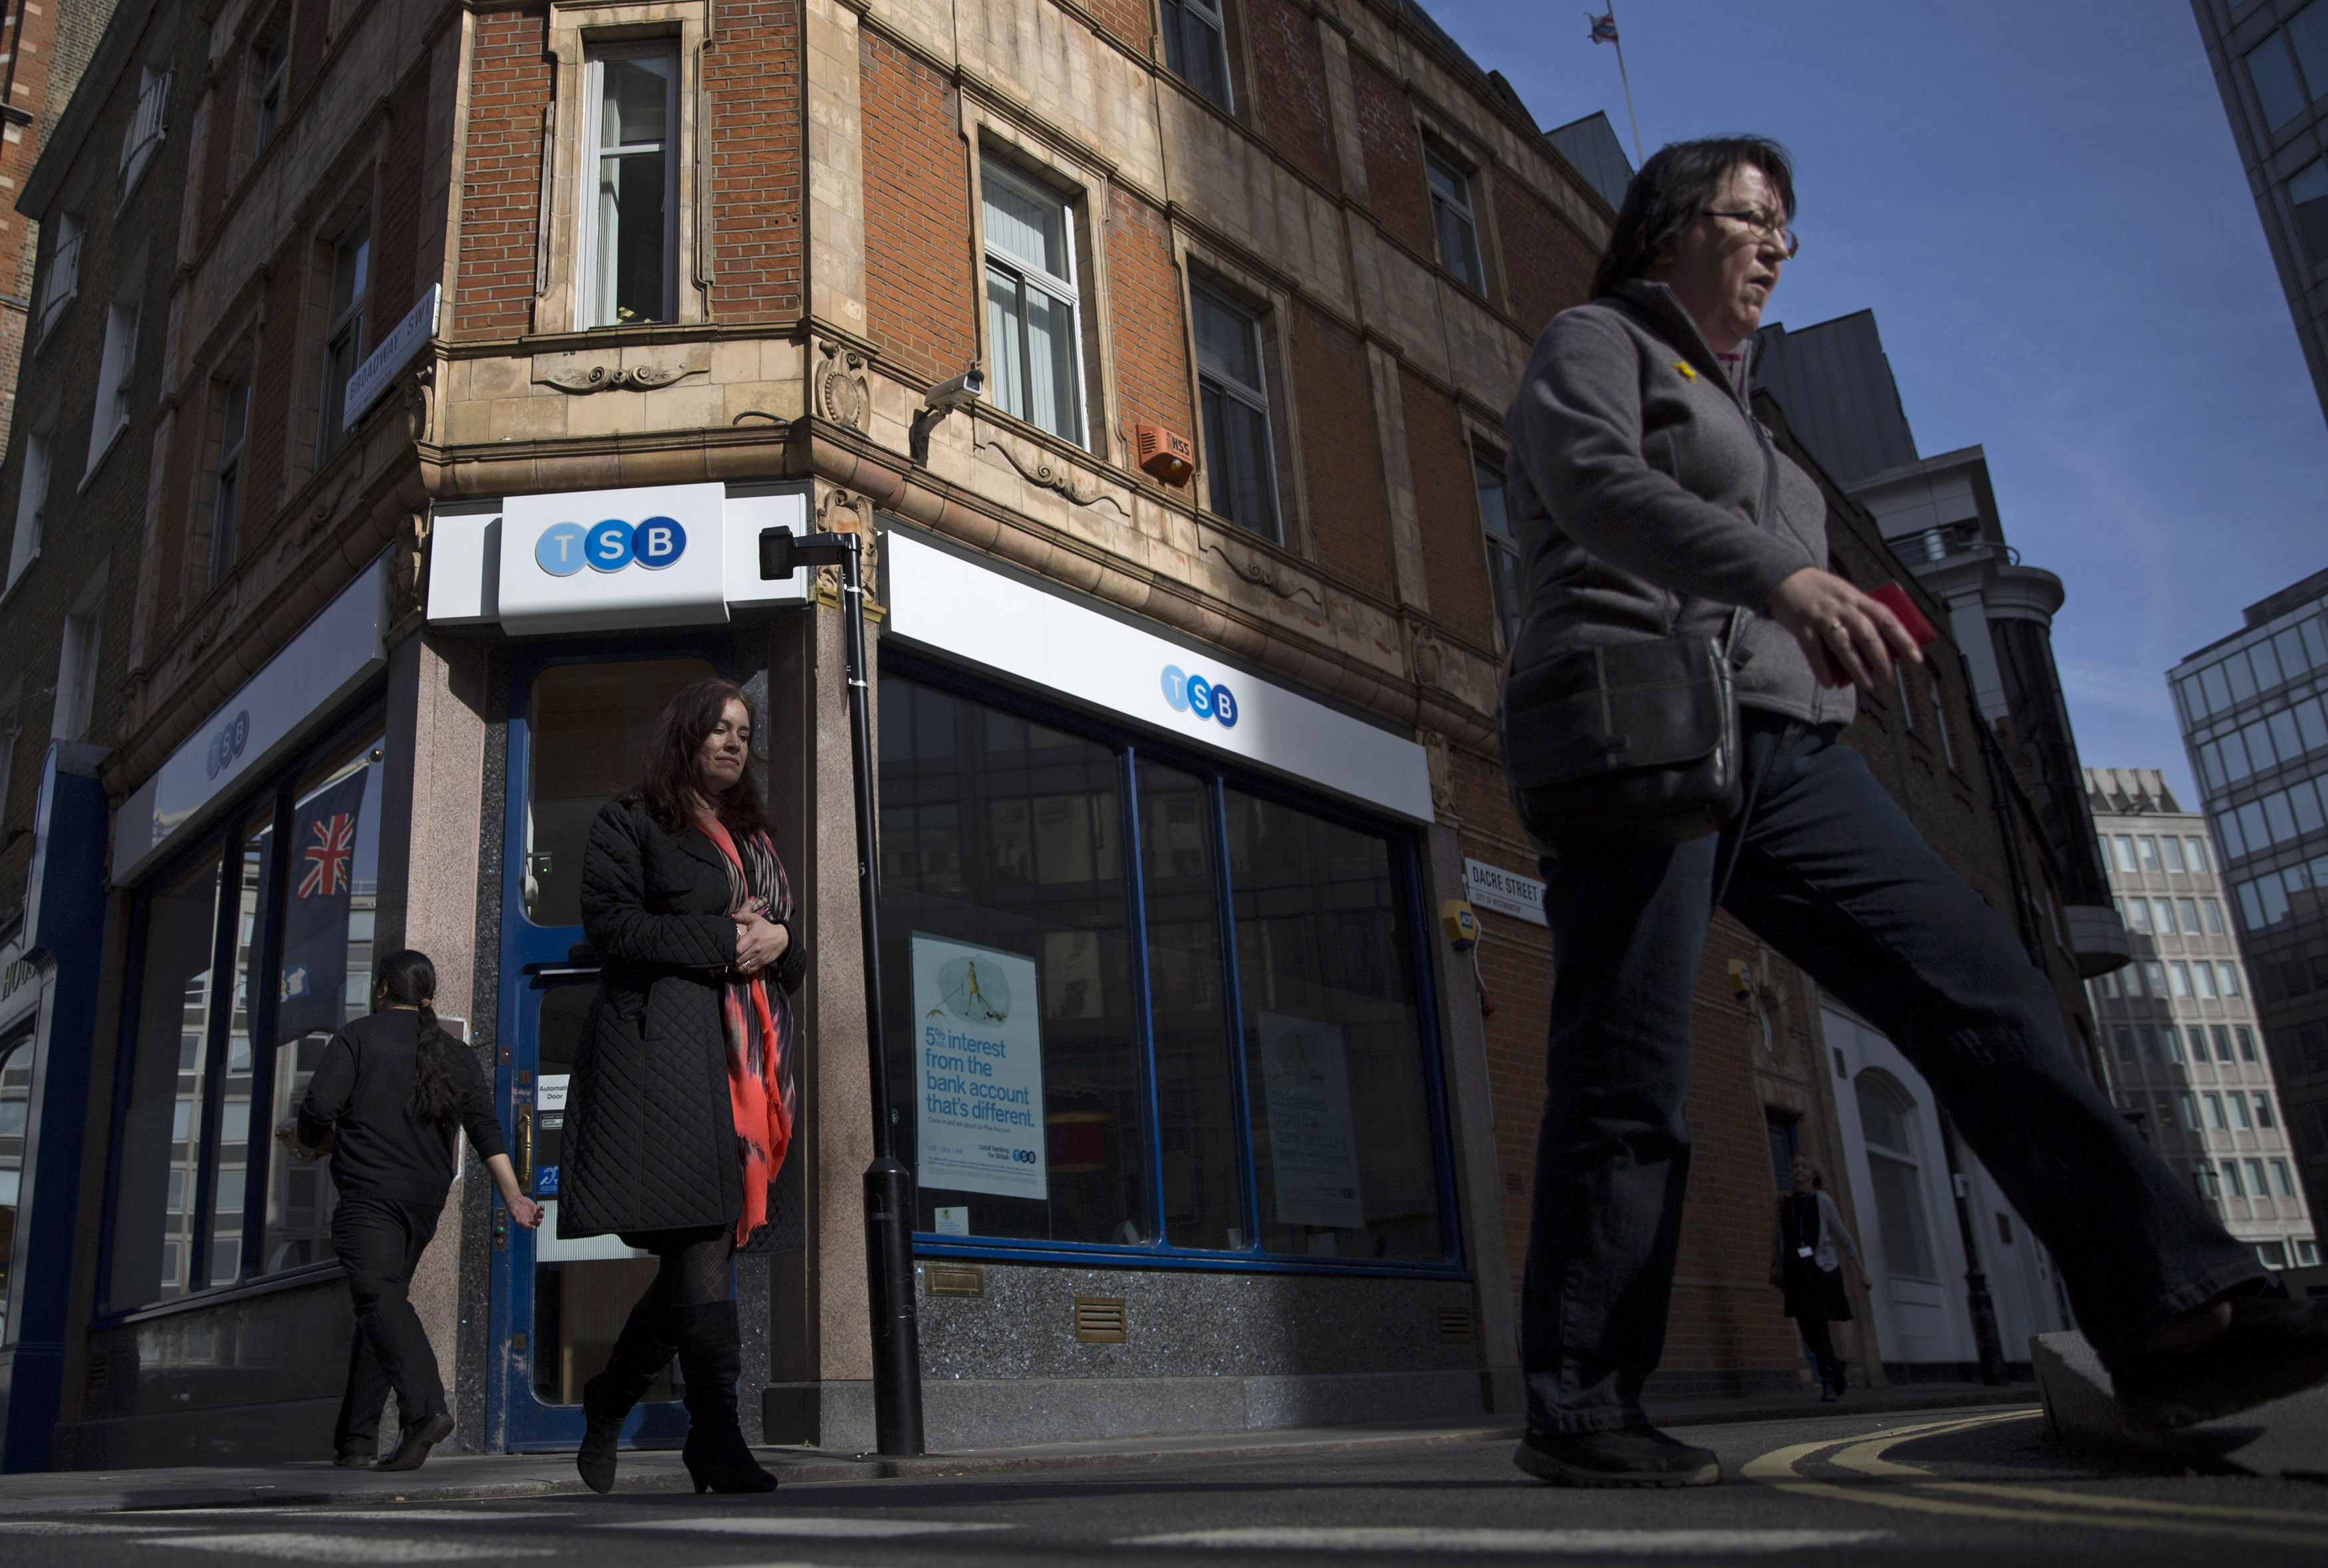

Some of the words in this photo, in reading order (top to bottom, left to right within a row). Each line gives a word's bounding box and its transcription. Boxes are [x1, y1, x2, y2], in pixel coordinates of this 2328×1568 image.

[350, 330, 400, 400] BROADWAY
[407, 298, 430, 336] SW1
[1172, 436, 1190, 456] HSS
[551, 524, 676, 565] TSB
[1169, 673, 1233, 720] TSB
[211, 719, 245, 770] TSB
[1472, 866, 1503, 891] DACRE
[1505, 877, 1537, 902] STREET
[926, 1027, 945, 1047] 5%
[948, 1029, 1006, 1059] interest
[925, 1048, 964, 1072] from
[967, 1055, 992, 1077] the
[927, 1070, 966, 1095] bank
[970, 1082, 1030, 1105] account
[926, 1093, 969, 1117] that's
[972, 1101, 1035, 1128] different.
[992, 1145, 1010, 1154] banking
[1014, 1150, 1034, 1162] TSB
